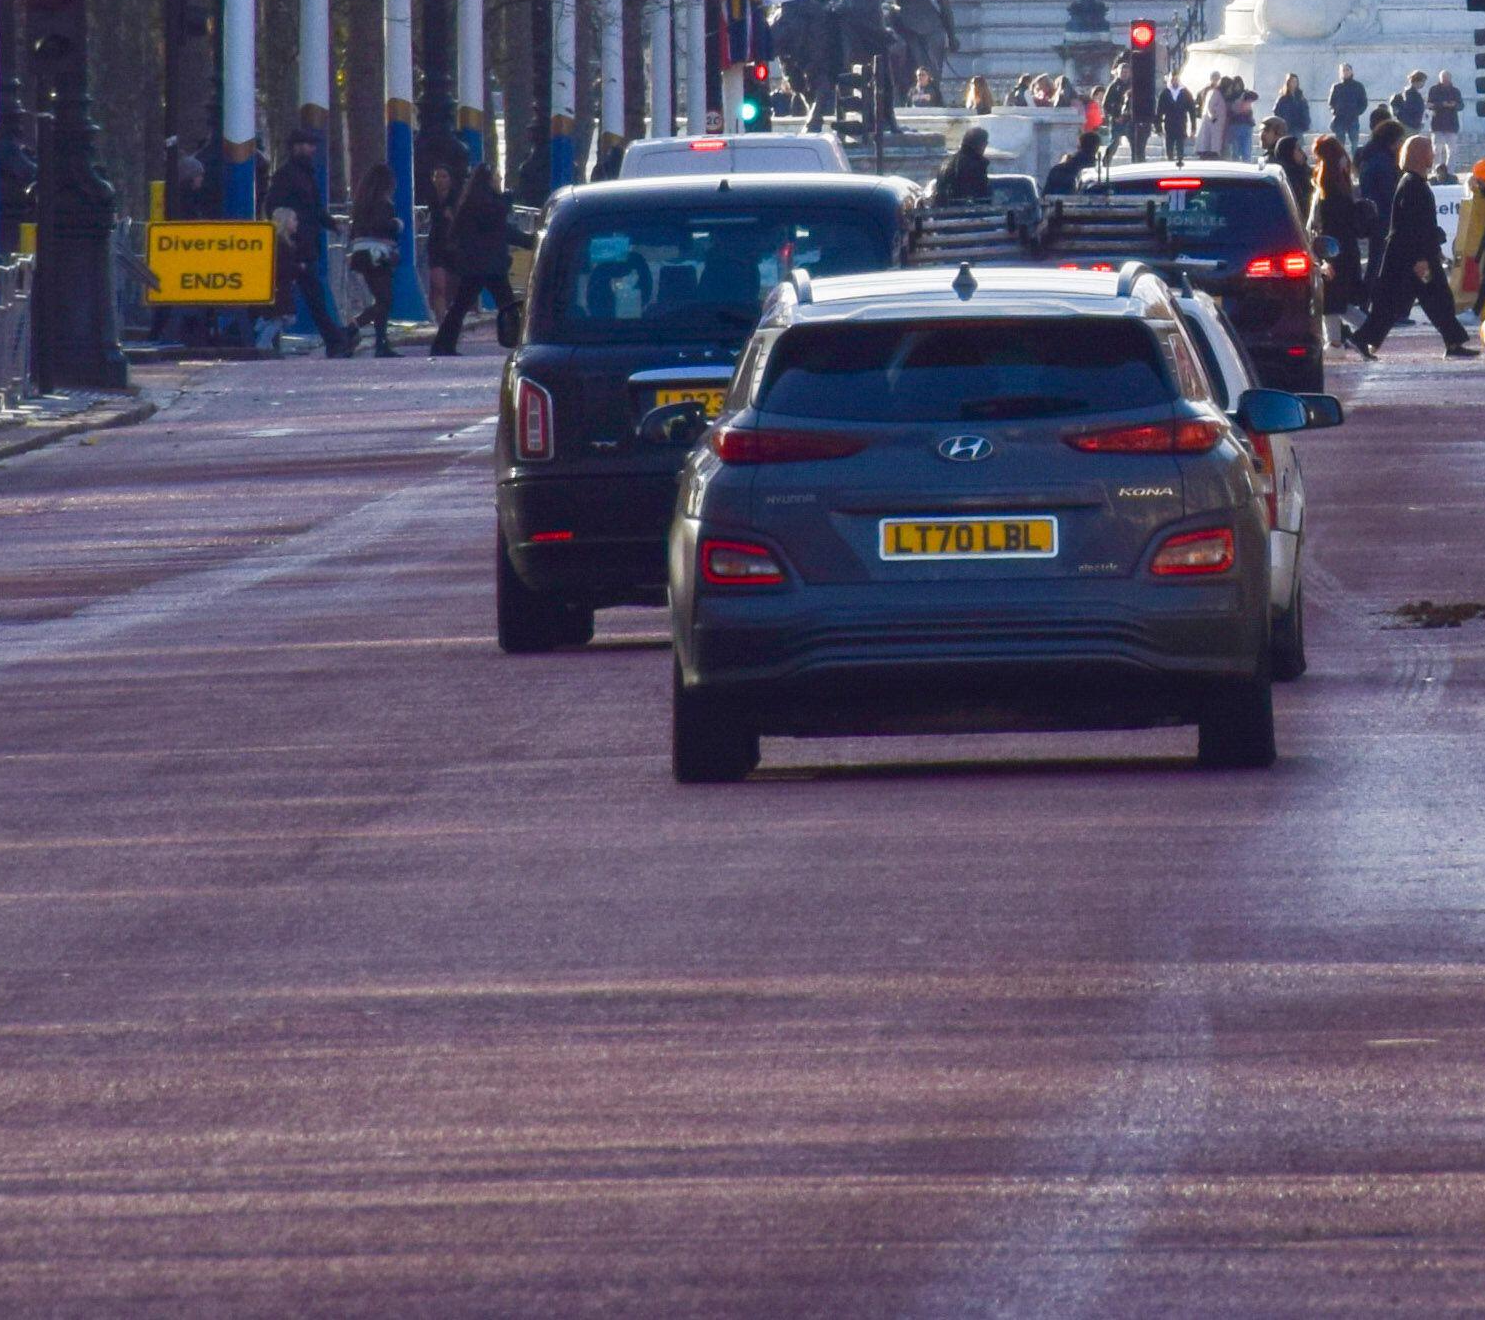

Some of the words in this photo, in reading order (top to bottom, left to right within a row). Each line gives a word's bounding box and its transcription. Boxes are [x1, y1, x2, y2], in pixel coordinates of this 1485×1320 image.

[158, 235, 263, 251] Diversion
[180, 272, 243, 289] ENDS
[1119, 487, 1174, 497] KONA
[895, 524, 974, 553] LT70
[982, 523, 1042, 551] LBL
